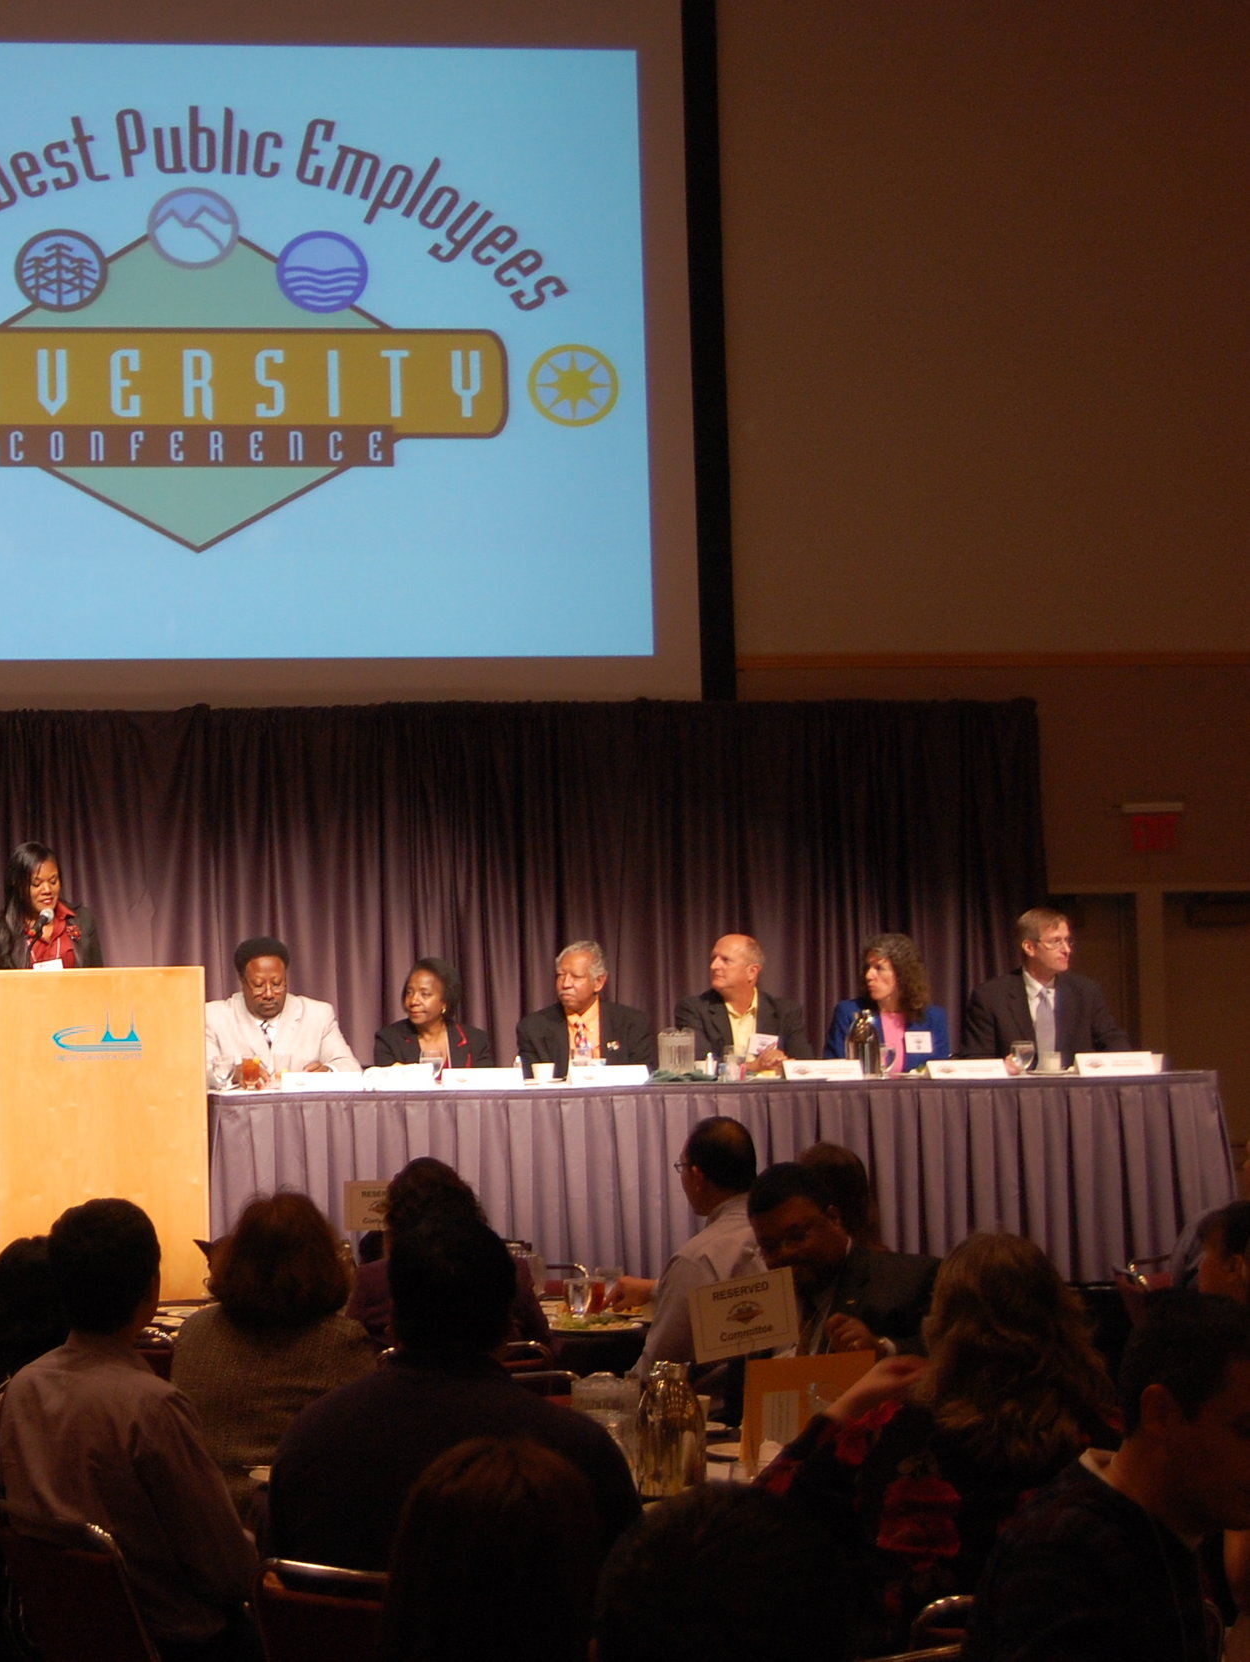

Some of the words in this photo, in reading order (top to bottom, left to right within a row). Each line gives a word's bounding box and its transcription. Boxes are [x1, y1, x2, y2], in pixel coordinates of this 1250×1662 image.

[116, 105, 283, 179] Public
[297, 118, 569, 312] Employees
[8, 430, 383, 463] CONFERENCE
[712, 1281, 769, 1301] RESERVED
[720, 1324, 773, 1342] Committee
